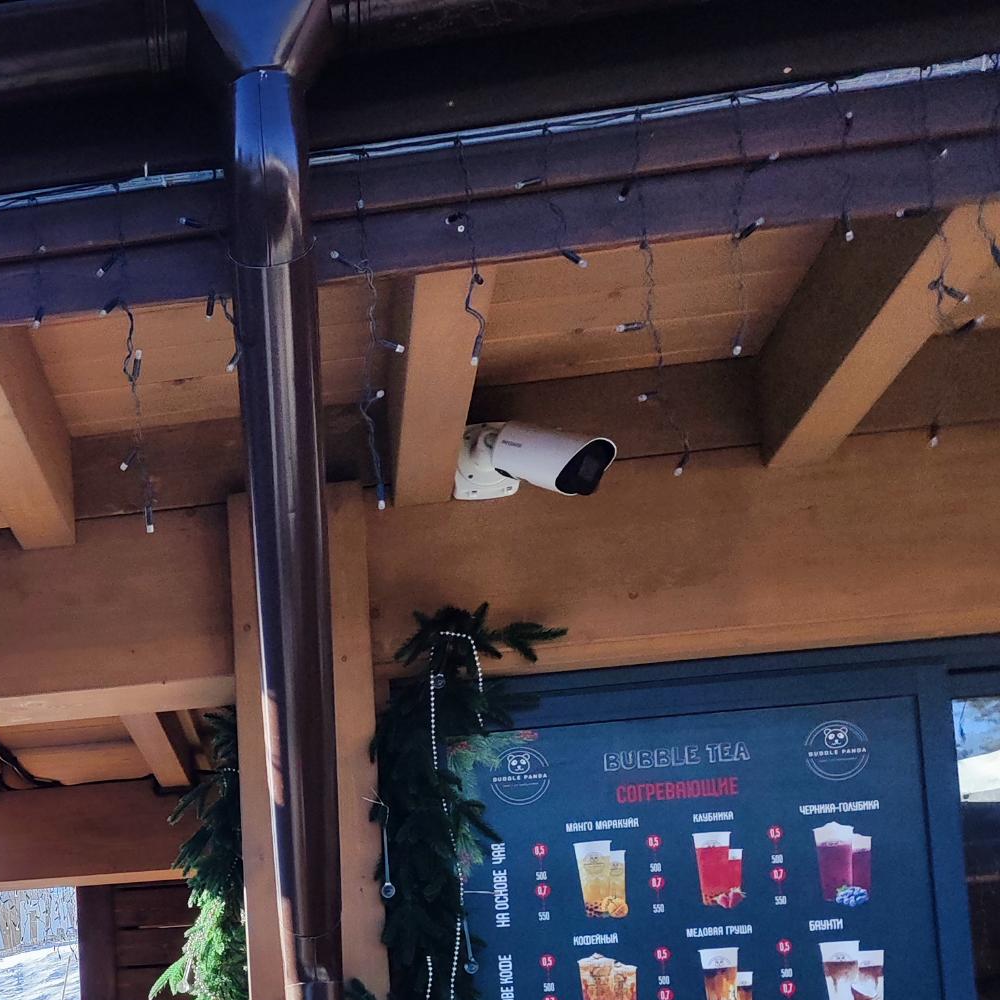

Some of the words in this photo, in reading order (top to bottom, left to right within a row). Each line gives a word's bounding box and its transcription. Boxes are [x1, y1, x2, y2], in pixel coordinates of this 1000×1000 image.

[603, 745, 700, 772] BUBBLE
[706, 741, 751, 764] TEA
[616, 778, 739, 804] СОГРЕВАЮЩИЕ
[799, 800, 880, 815] ЧЕРНИКА-ГОЛУБИКА
[692, 811, 735, 824] КЛУБНИКА
[565, 819, 593, 832] МАНГО
[595, 817, 640, 831] МАРАКУЙЯ
[490, 842, 506, 865] ЧАЯ
[771, 854, 784, 864] 500
[650, 863, 662, 873] 500
[535, 871, 548, 881] 500
[493, 868, 509, 911] ОСНОВЕ
[774, 896, 787, 905] 550
[653, 903, 665, 913] 550
[495, 911, 511, 928] НА
[538, 911, 550, 921] 550
[686, 926, 724, 938] МЕДОВАЯ
[725, 924, 753, 936] ГРУША
[809, 918, 844, 931] БАУНТИ
[573, 932, 619, 946] КОФЕЙНЫЙ
[498, 954, 513, 985] КОФЕ
[780, 968, 793, 978] 500
[658, 975, 670, 985] 500
[543, 982, 555, 992] 500
